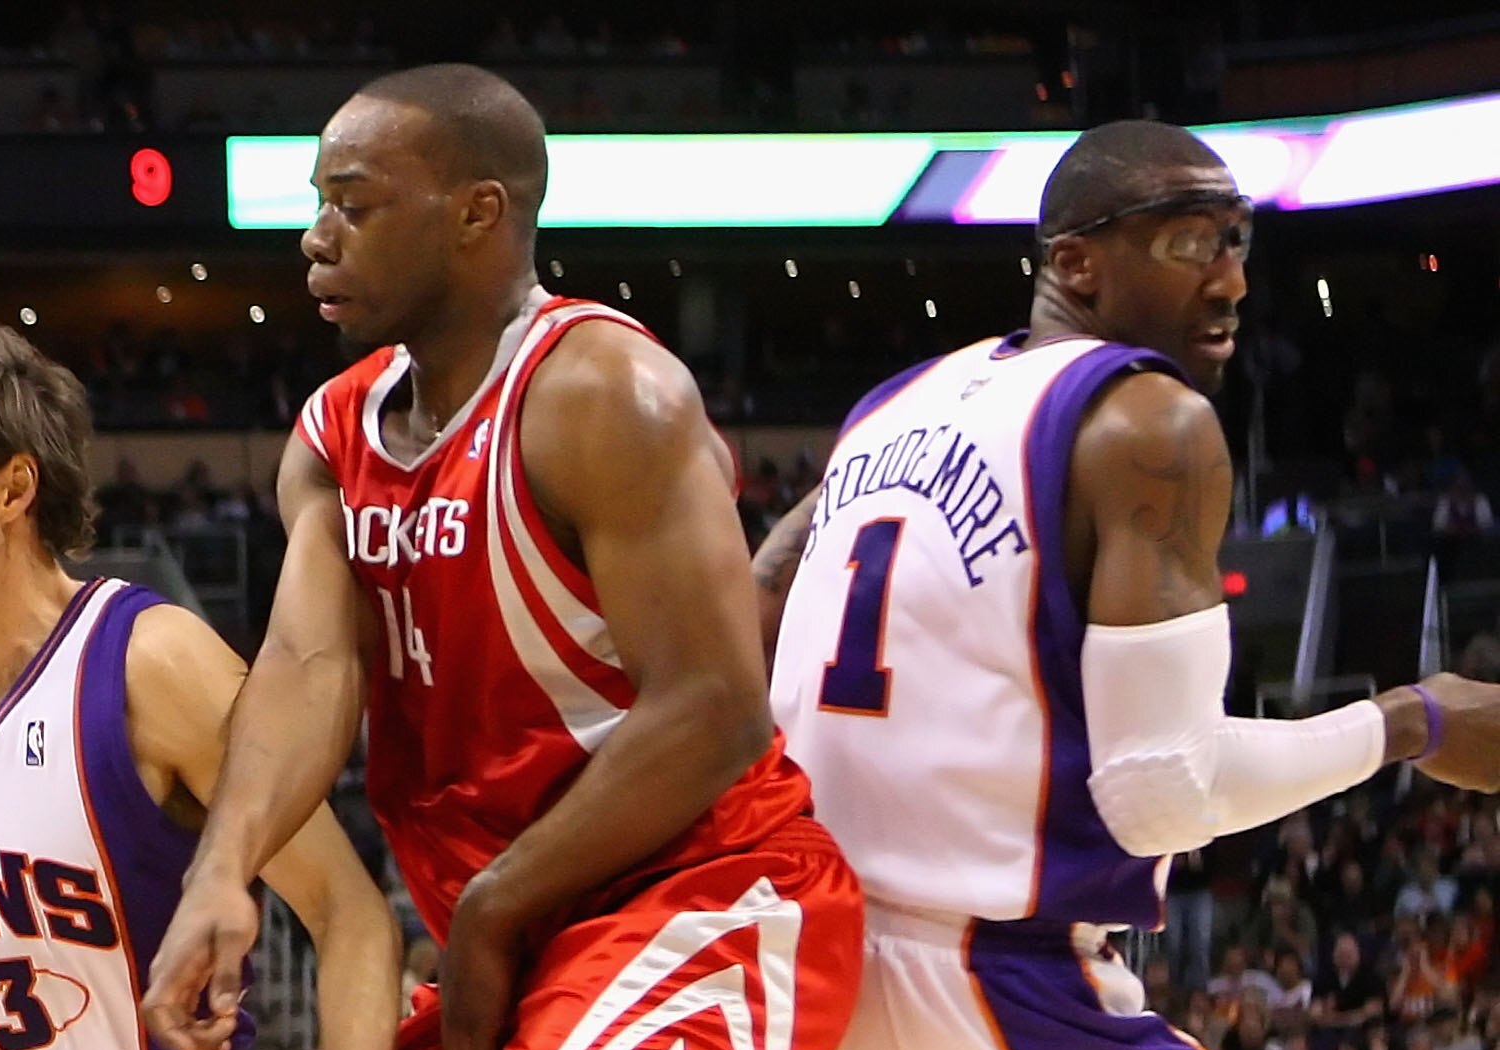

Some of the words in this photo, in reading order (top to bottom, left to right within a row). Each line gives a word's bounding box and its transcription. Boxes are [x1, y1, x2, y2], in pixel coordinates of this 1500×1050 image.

[130, 147, 172, 207] 9
[377, 584, 435, 687] 14
[816, 516, 907, 718] 1
